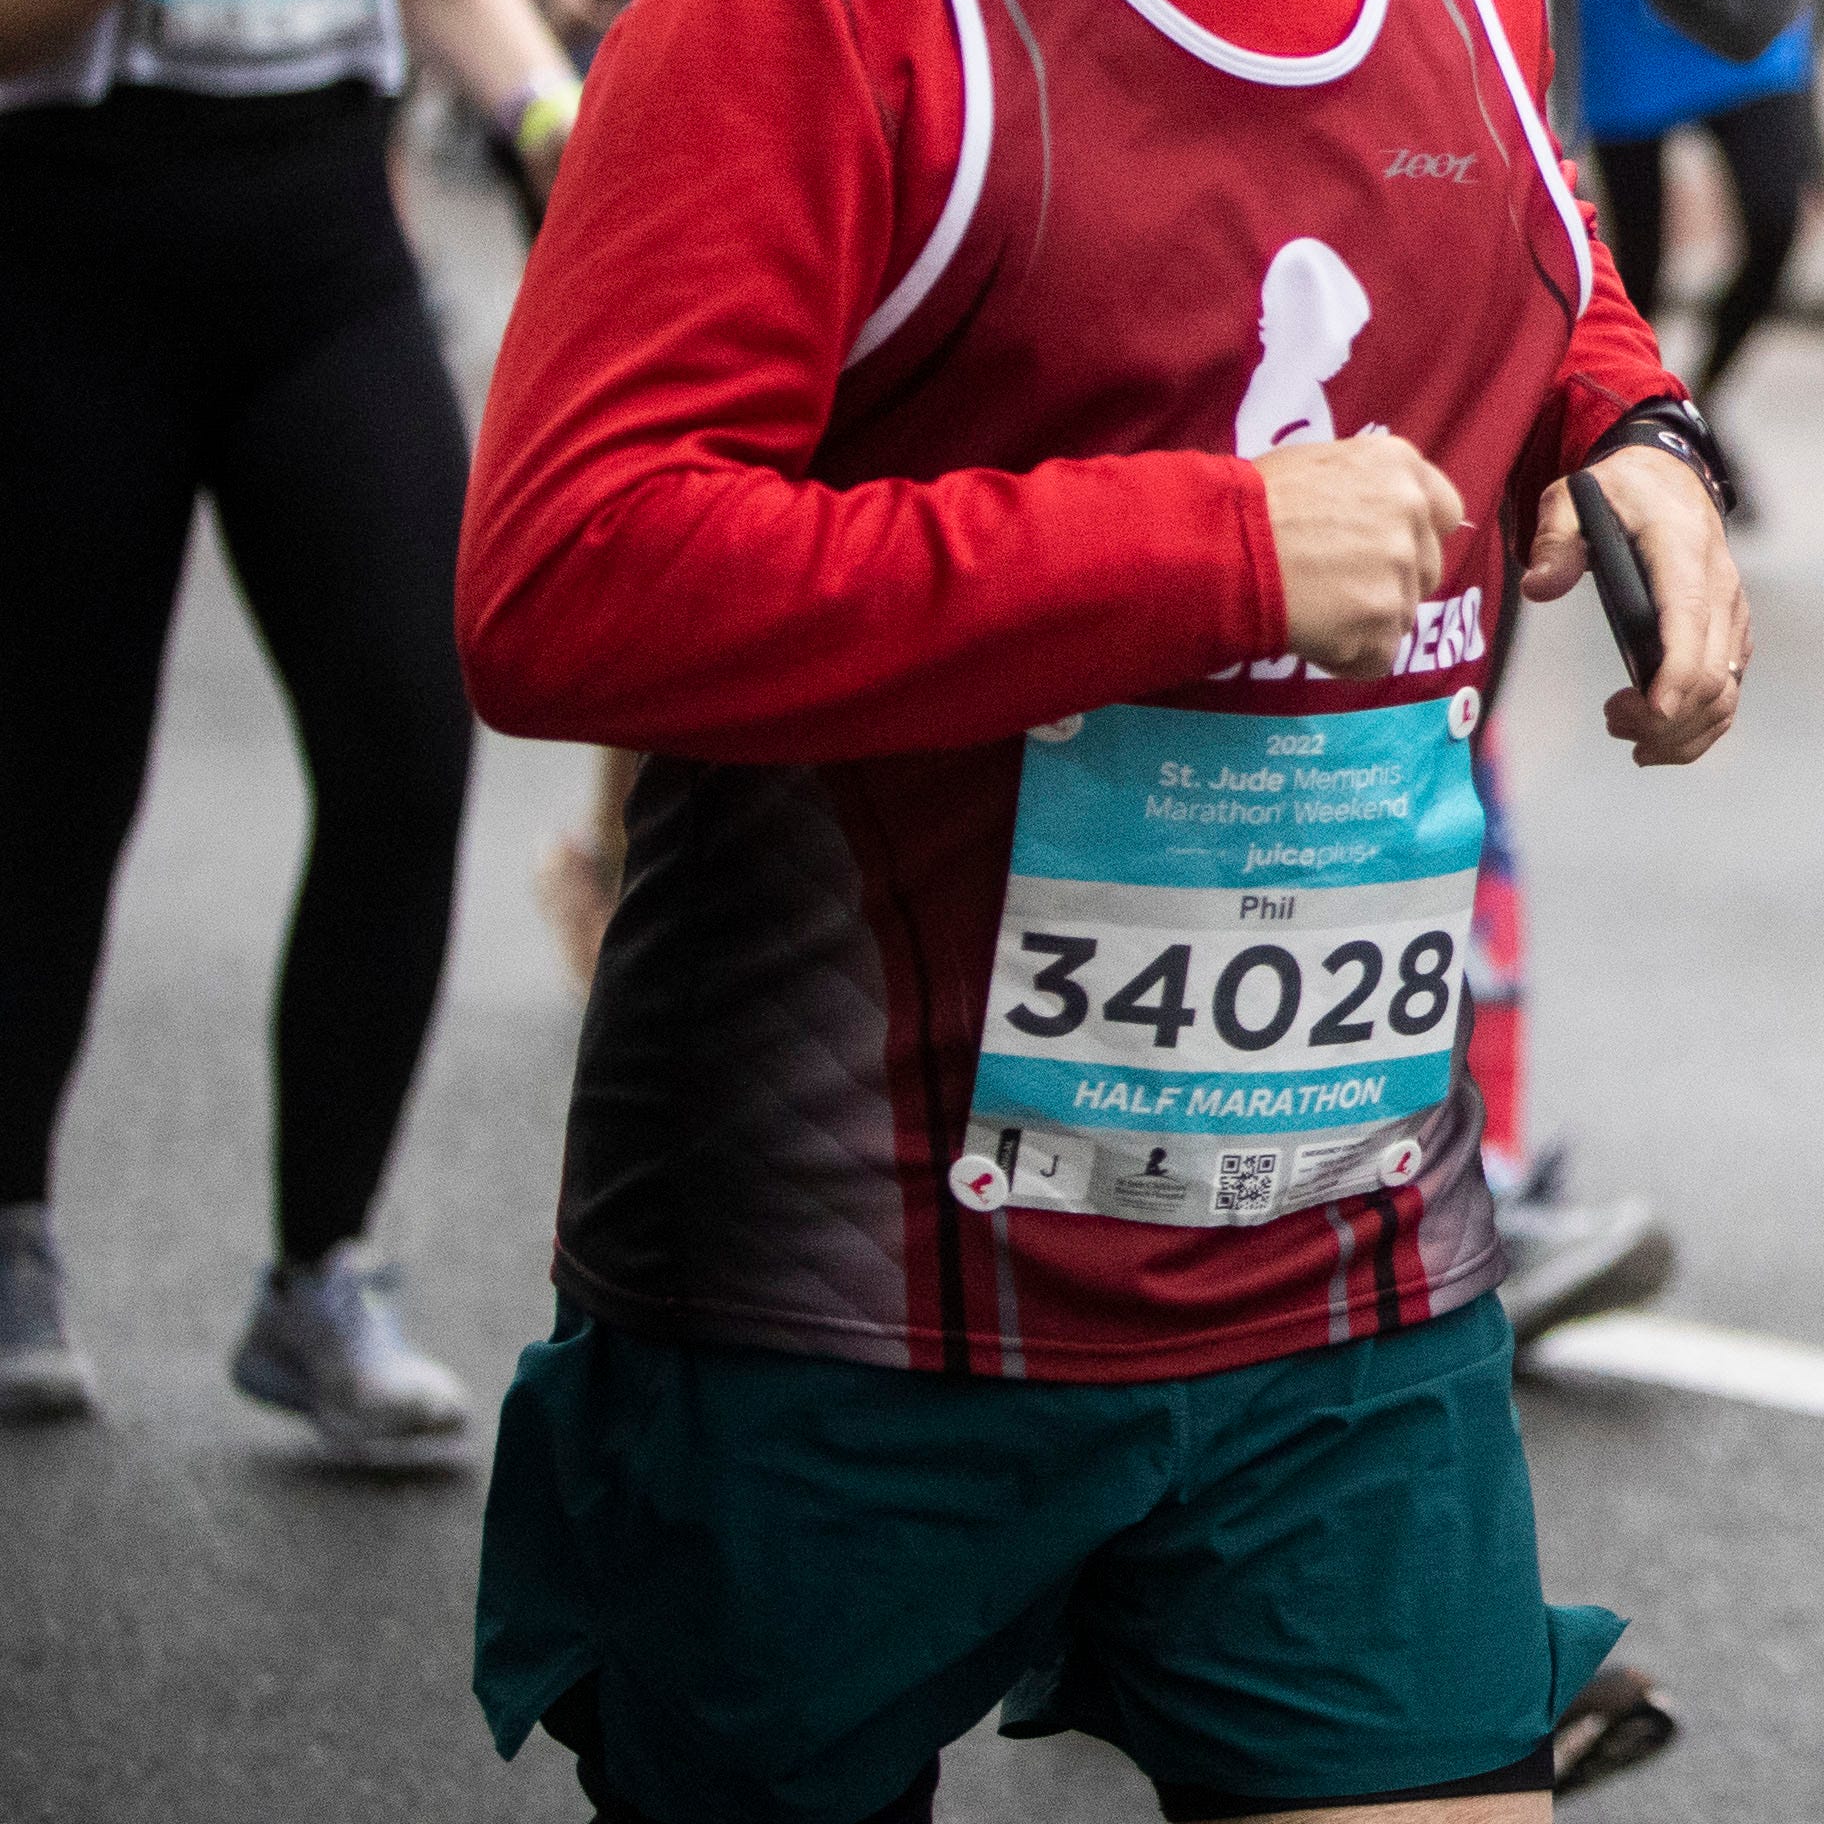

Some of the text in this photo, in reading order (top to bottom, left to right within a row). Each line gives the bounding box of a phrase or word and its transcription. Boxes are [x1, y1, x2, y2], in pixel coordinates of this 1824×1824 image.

[1266, 732, 1326, 756] 2022
[1159, 760, 1403, 793] St. Jude Memphis
[1145, 791, 1410, 825] Marathon Weekend
[1239, 894, 1297, 922] Phil
[1005, 930, 1454, 1052] 34028
[1074, 1075, 1387, 1117] HALF MARATHON
[1040, 1155, 1058, 1177] J
